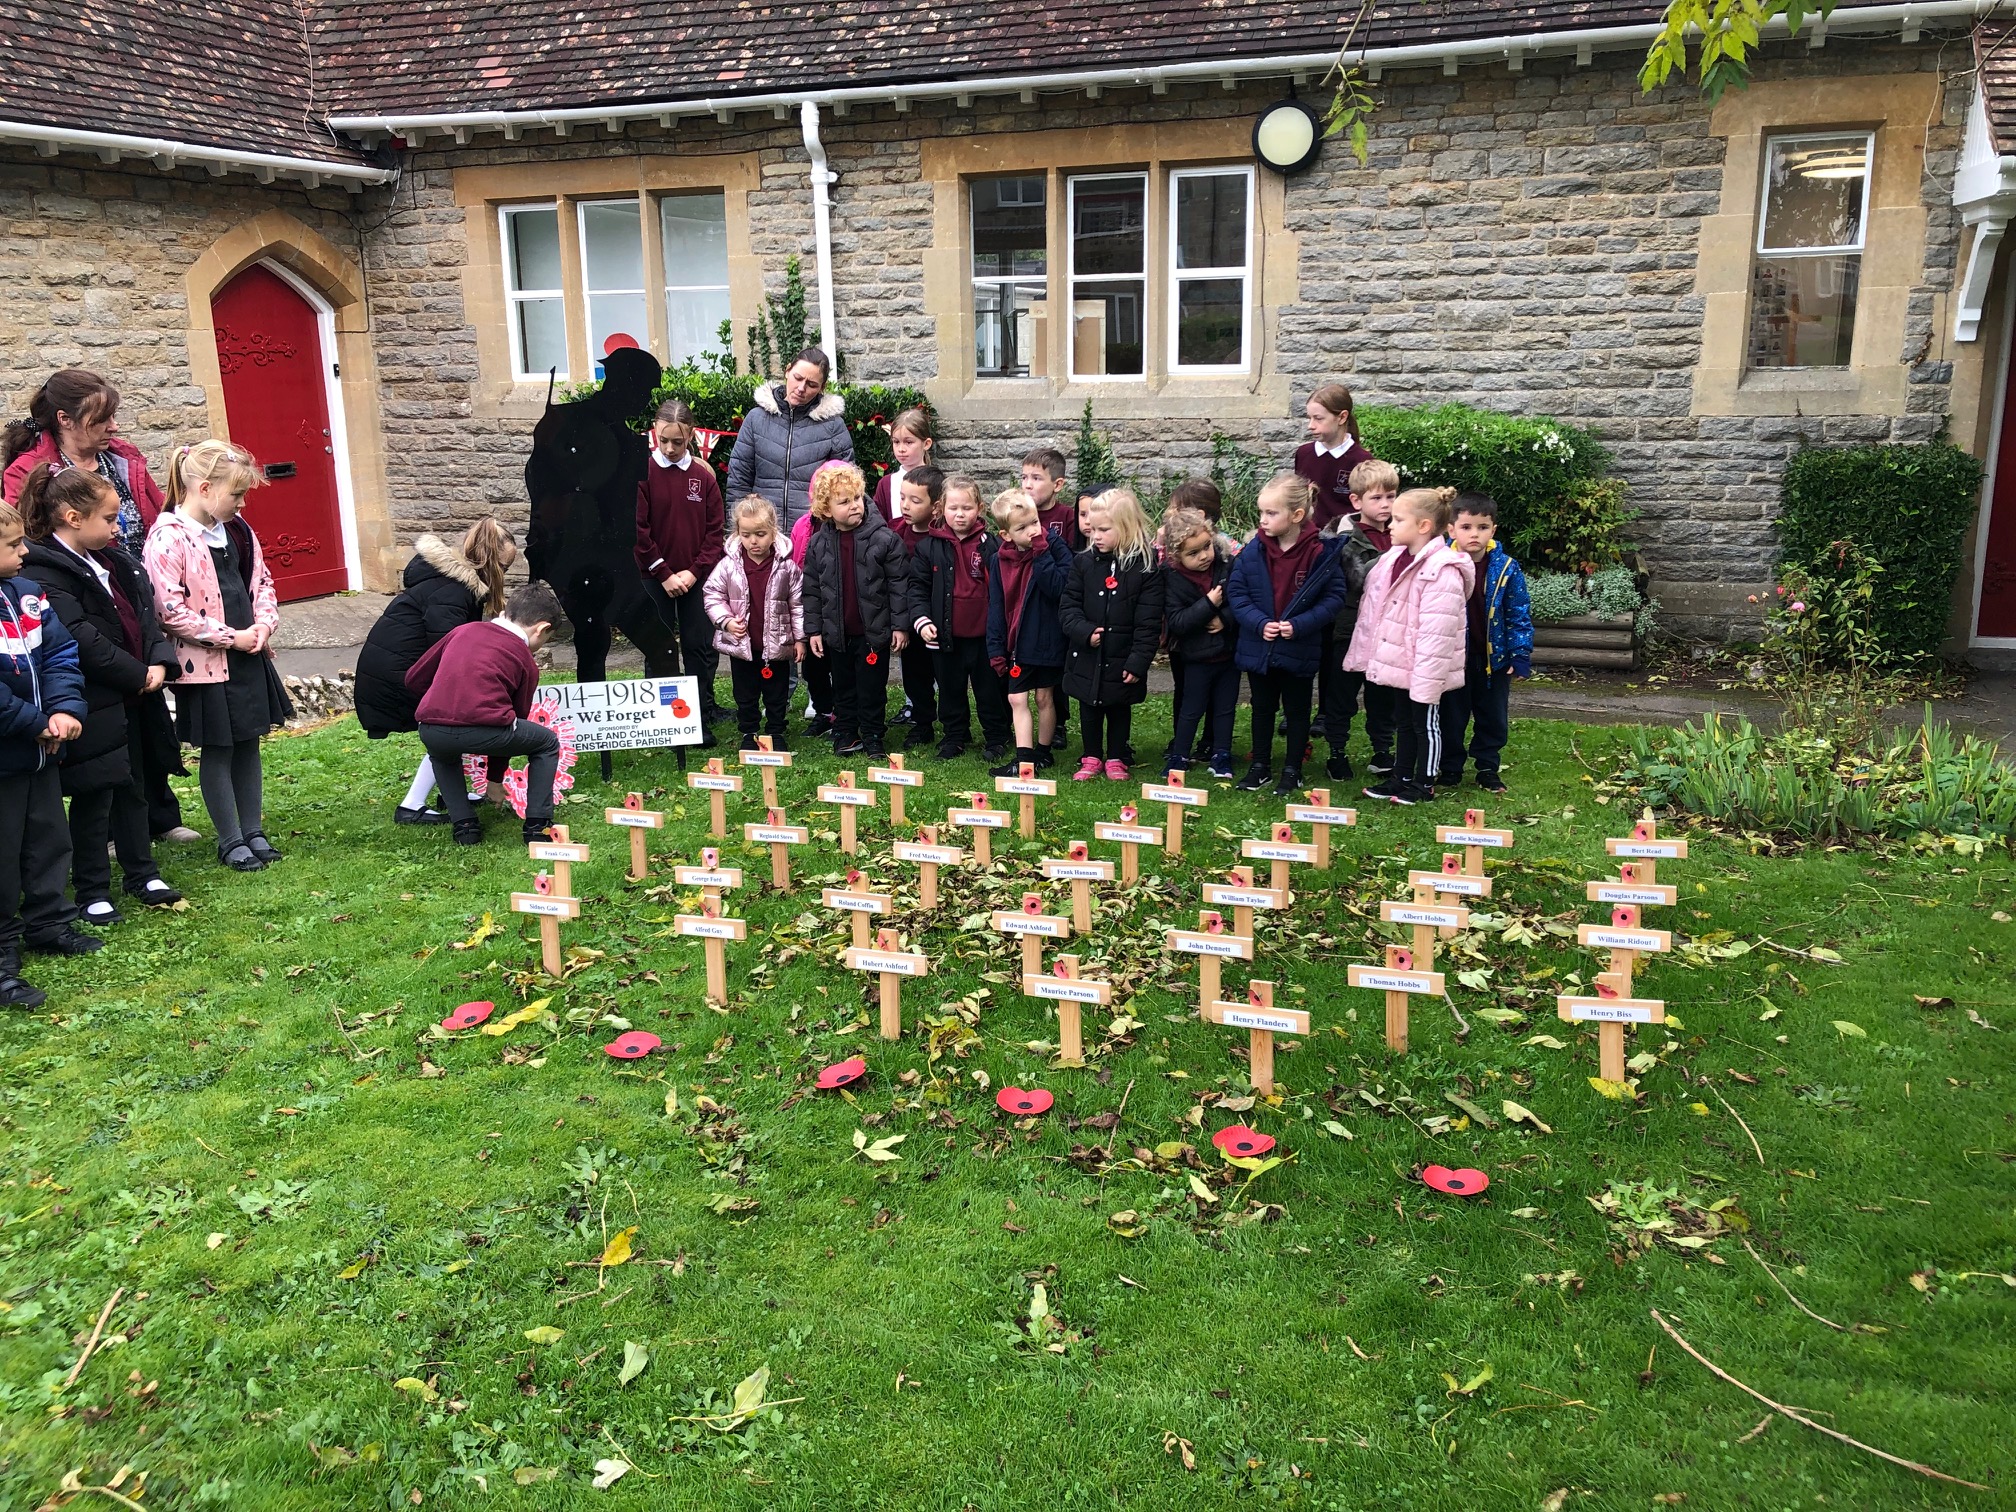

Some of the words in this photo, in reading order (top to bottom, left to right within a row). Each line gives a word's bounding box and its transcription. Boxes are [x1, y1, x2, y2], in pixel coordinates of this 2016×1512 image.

[576, 711, 601, 723] We
[606, 709, 656, 723] Forget
[571, 732, 602, 742] OPLE
[607, 731, 627, 740] AND
[629, 728, 682, 738] CHILDREN
[684, 726, 697, 734] OF
[636, 737, 672, 747] PARISH
[1206, 944, 1230, 952] Dennett
[884, 962, 908, 970] Ashford
[1368, 978, 1396, 986] Thomas
[1398, 980, 1420, 988] Hobbs
[1041, 987, 1067, 995] Maurice
[1068, 990, 1094, 998] Parsons
[1590, 1009, 1614, 1018] Henry
[1232, 1015, 1254, 1025] Henry
[1257, 1018, 1289, 1028] Flanders
